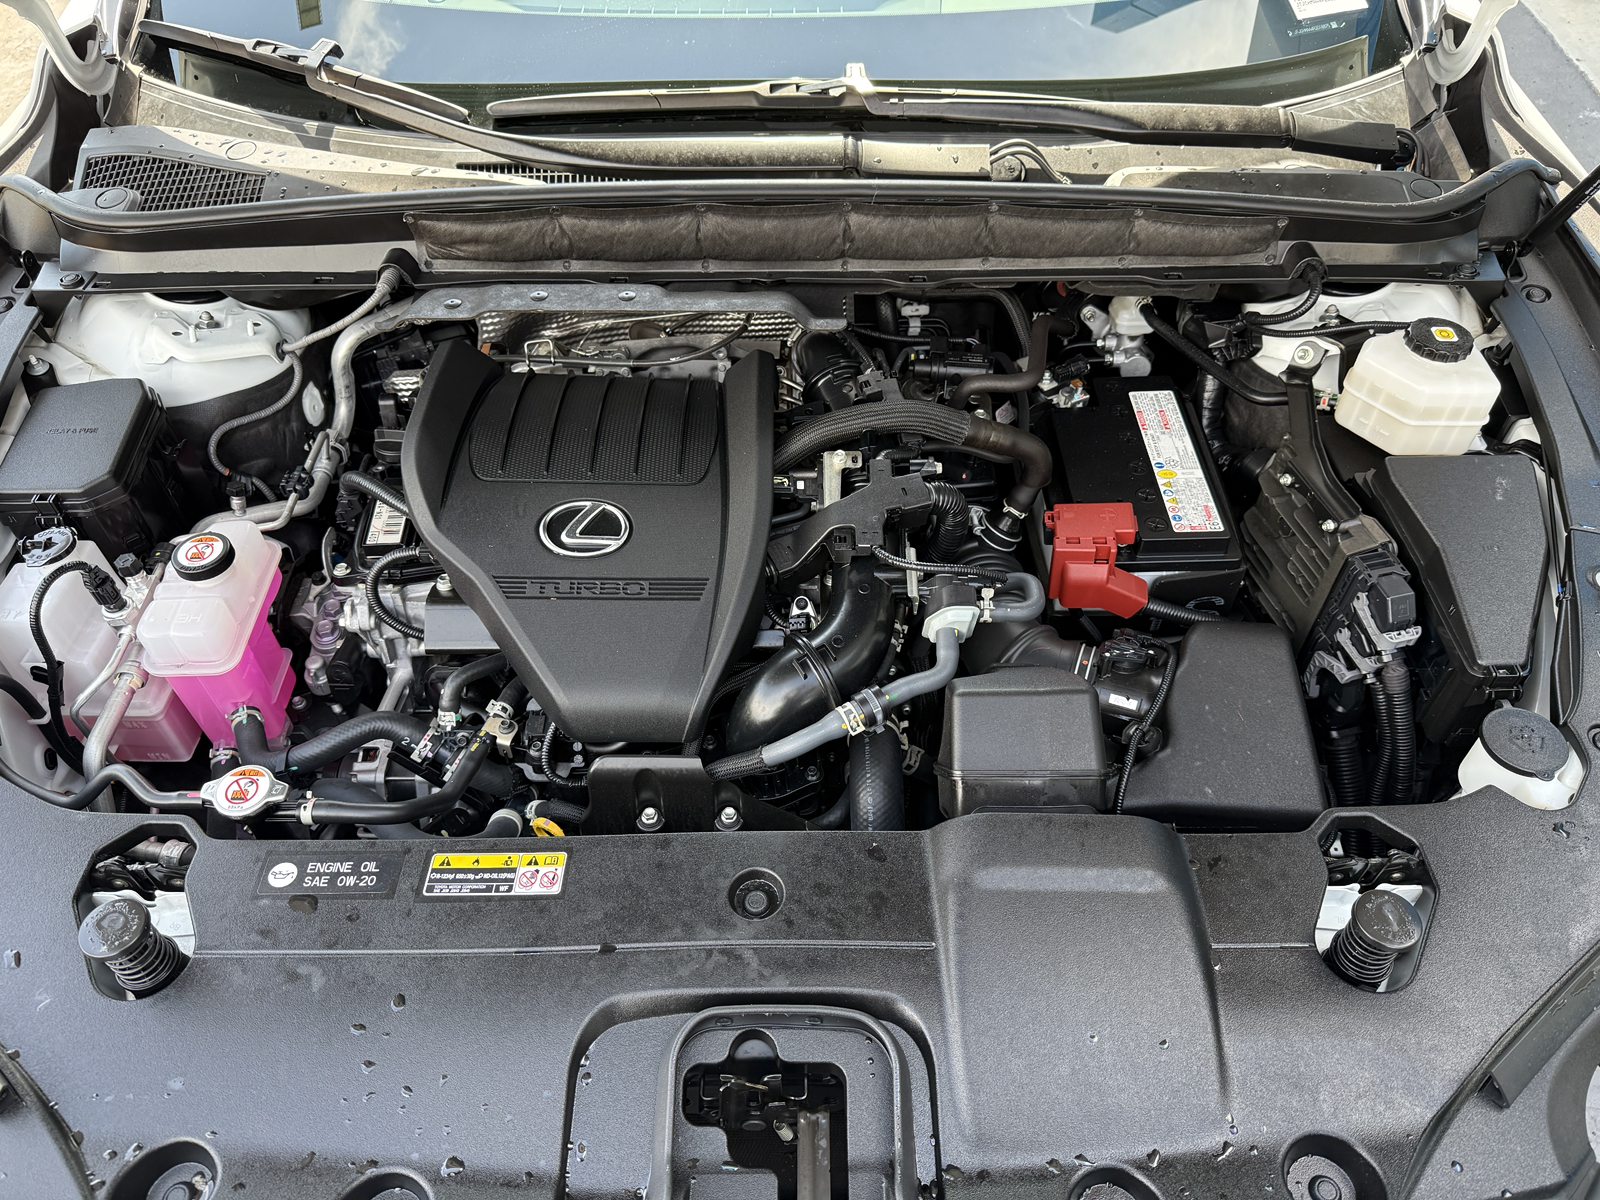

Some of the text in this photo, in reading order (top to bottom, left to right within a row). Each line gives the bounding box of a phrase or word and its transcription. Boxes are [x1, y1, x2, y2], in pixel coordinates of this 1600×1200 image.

[530, 580, 647, 596] TURBO
[122, 721, 147, 729] MAX
[147, 752, 171, 760] MIN
[306, 861, 380, 873] ENGINE OIL
[302, 875, 377, 887] SAE 0W-20
